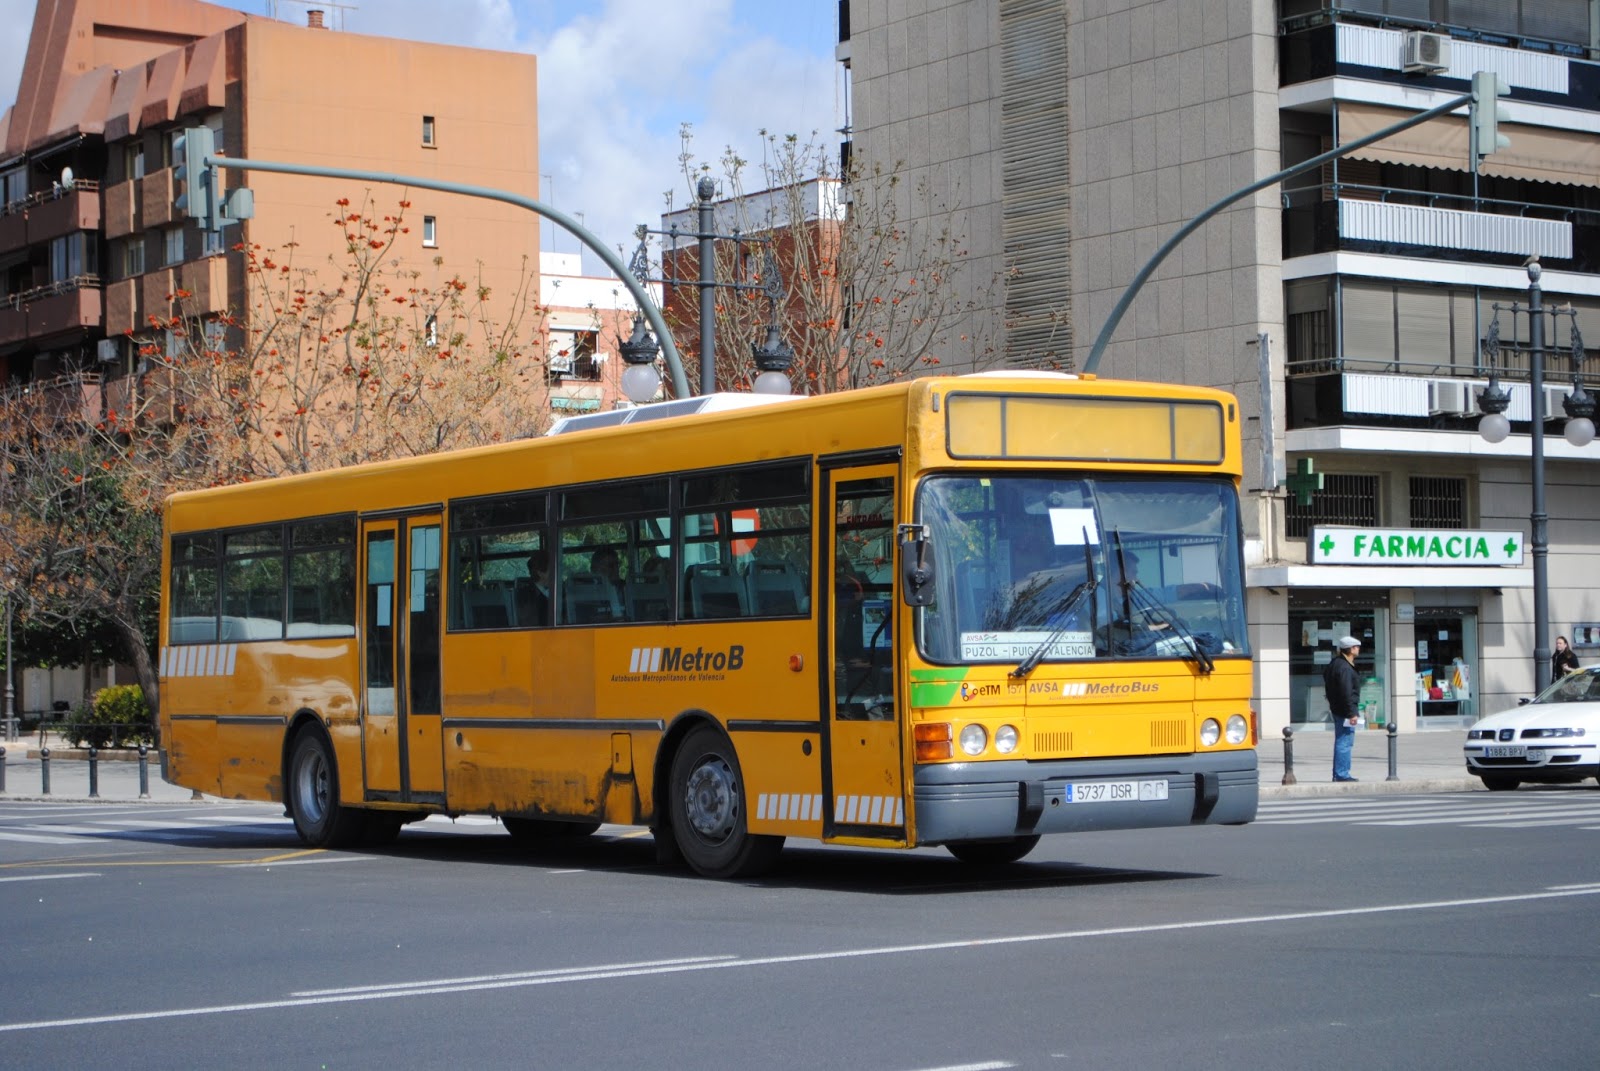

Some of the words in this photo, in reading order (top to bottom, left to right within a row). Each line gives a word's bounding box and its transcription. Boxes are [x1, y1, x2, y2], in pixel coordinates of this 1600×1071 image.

[1354, 534, 1490, 558] FARMACIA
[965, 646, 998, 657] PUZOL
[1012, 646, 1034, 656] PUIG
[1049, 645, 1093, 656] VALENCIA
[660, 645, 744, 671] MetroB
[610, 674, 641, 682] Autobuses
[642, 673, 687, 683] Metropolitanos
[688, 673, 696, 681] de
[698, 673, 725, 681] Valencia
[979, 684, 1001, 696] eTM
[1029, 682, 1058, 693] AVSA
[1085, 682, 1159, 694] MetroBus
[1529, 752, 1543, 760] SP
[1077, 785, 1106, 799] 5737
[1110, 784, 1132, 798] DSR
